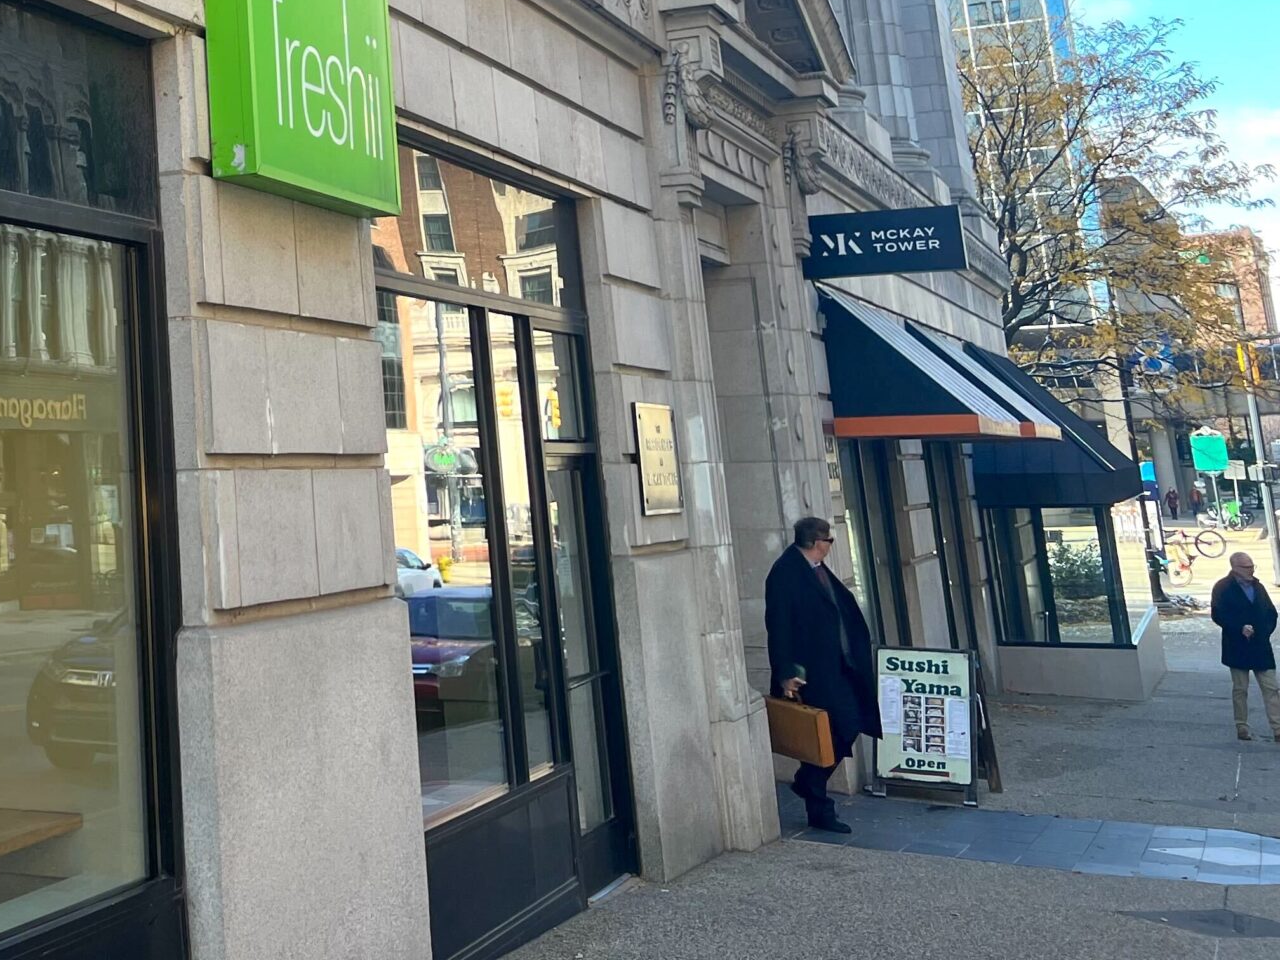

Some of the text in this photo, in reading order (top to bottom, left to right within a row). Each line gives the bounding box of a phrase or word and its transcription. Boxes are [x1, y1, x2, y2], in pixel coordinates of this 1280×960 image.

[871, 226, 935, 241] MCKAY
[873, 239, 940, 253] TOWER
[886, 656, 949, 675] Sushi
[901, 678, 962, 697] Yama
[905, 757, 946, 770] Open
